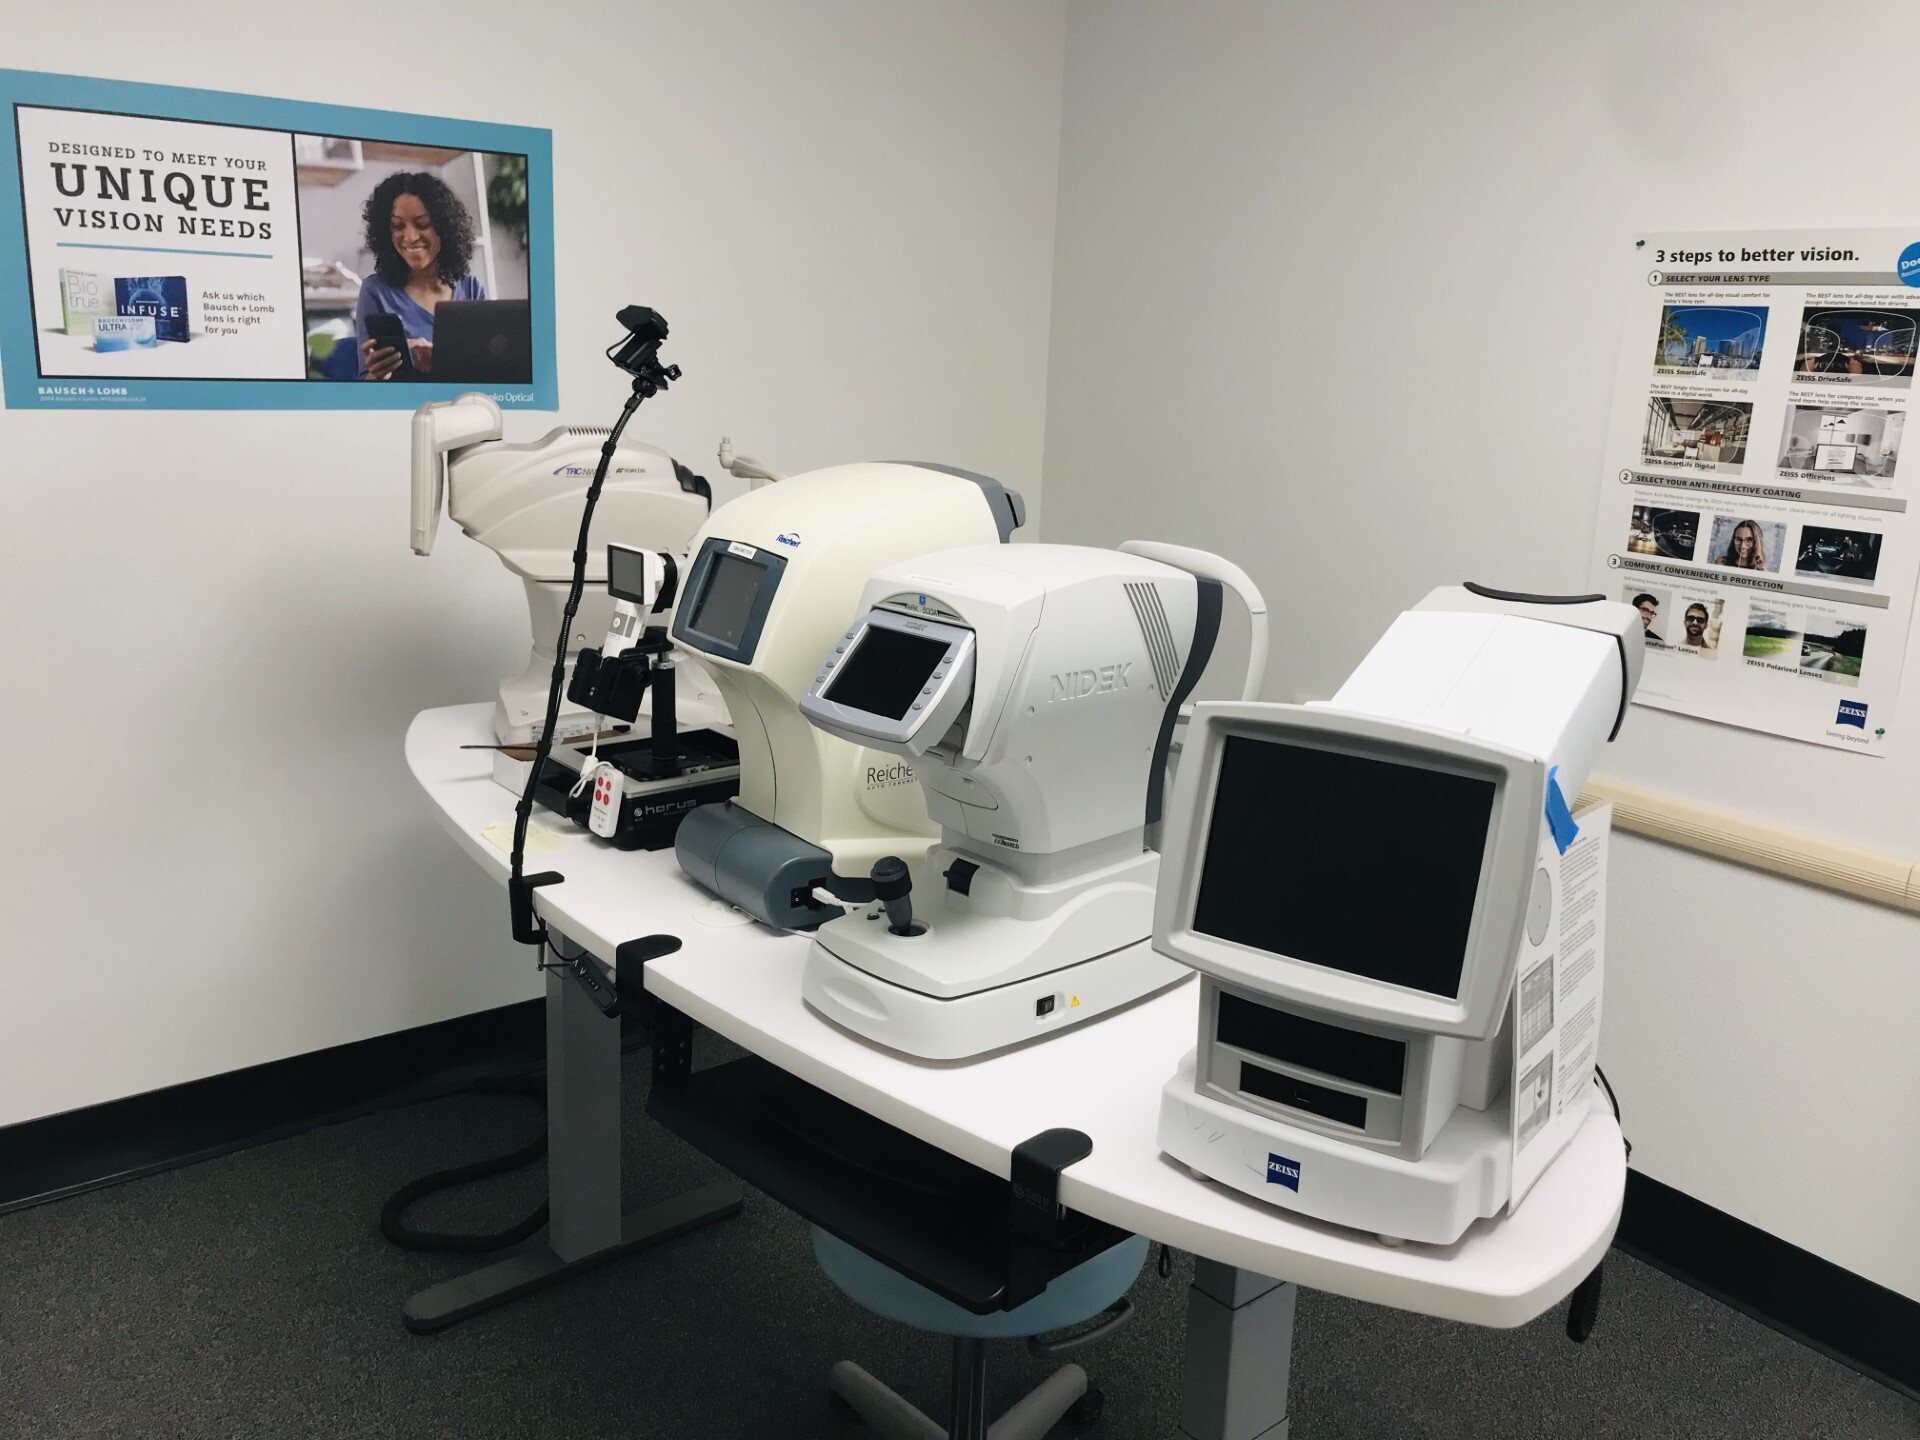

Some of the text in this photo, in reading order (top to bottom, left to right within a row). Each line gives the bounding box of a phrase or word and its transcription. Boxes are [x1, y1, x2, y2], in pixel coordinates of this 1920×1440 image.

[48, 142, 267, 171] DESIGNED TO MEET YOUR
[50, 161, 270, 212] UNIQUE
[53, 207, 272, 240] VISION NEEDS
[1655, 246, 1860, 266] 3 steps to better vision.
[67, 275, 98, 296] Bio
[1665, 275, 1695, 283] SELECT
[1697, 275, 1721, 283] YOUR
[1723, 275, 1745, 283] LENS
[1748, 275, 1771, 283] TYPE
[69, 295, 99, 309] true
[202, 291, 220, 300] Ask
[236, 292, 265, 301] which
[121, 304, 180, 318] INFUSE
[203, 302, 239, 312] Bausch
[249, 305, 275, 313] Lomb
[204, 314, 261, 326] lens is right
[98, 323, 127, 332] ULTRA
[204, 325, 238, 336] for you
[1676, 368, 1707, 377] SmartLife
[1796, 374, 1852, 383] ZEISS DriveSafe
[1663, 459, 1693, 468] SmartLife
[1694, 461, 1716, 470] Digital
[1779, 470, 1836, 482] ZEISS Officelens
[1636, 475, 1664, 484] SELECT
[1666, 478, 1687, 487] YOUR
[1689, 480, 1761, 494] ANTI-REFLECTIVE
[1762, 488, 1802, 499] COATING
[776, 533, 801, 548] Reichert
[1624, 560, 1662, 572] COMFORT,
[1664, 566, 1720, 580] CONVENIENCE
[1730, 576, 1784, 590] PROTECTION
[1678, 645, 1699, 655] Lenses
[1746, 659, 1823, 679] ZEISS Polarized Lenses
[1047, 662, 1133, 703] NIDEK
[1839, 705, 1868, 718] ZEISS
[1825, 729, 1870, 744] Seeing beyond
[866, 761, 913, 784] Reiche
[889, 777, 918, 787] TONOMET
[645, 799, 697, 815] horus
[1268, 1161, 1299, 1179] ZEISS
